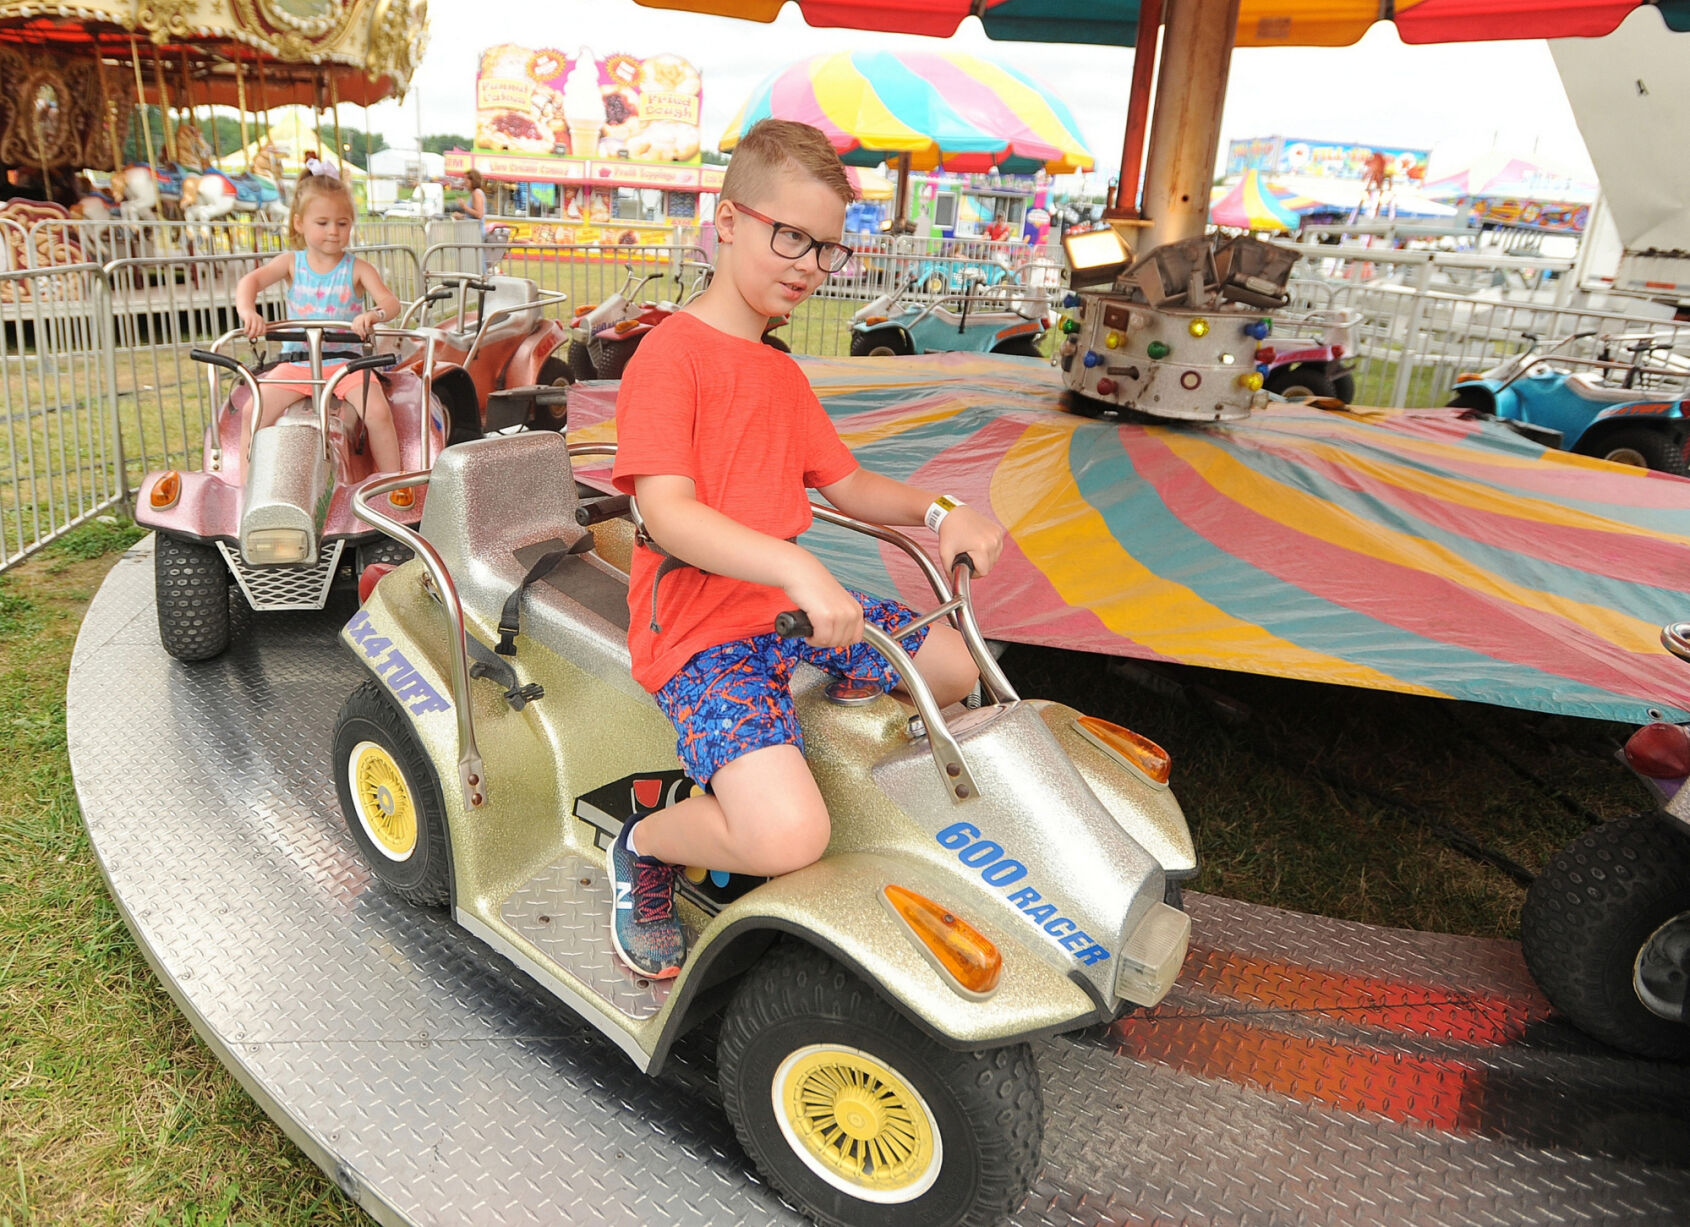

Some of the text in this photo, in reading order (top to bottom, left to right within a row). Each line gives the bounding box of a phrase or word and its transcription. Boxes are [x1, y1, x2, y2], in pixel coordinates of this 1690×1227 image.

[645, 104, 692, 119] Dough
[648, 95, 692, 107] Fried
[375, 648, 452, 716] TUFF
[935, 821, 1111, 966] 600 RACER
